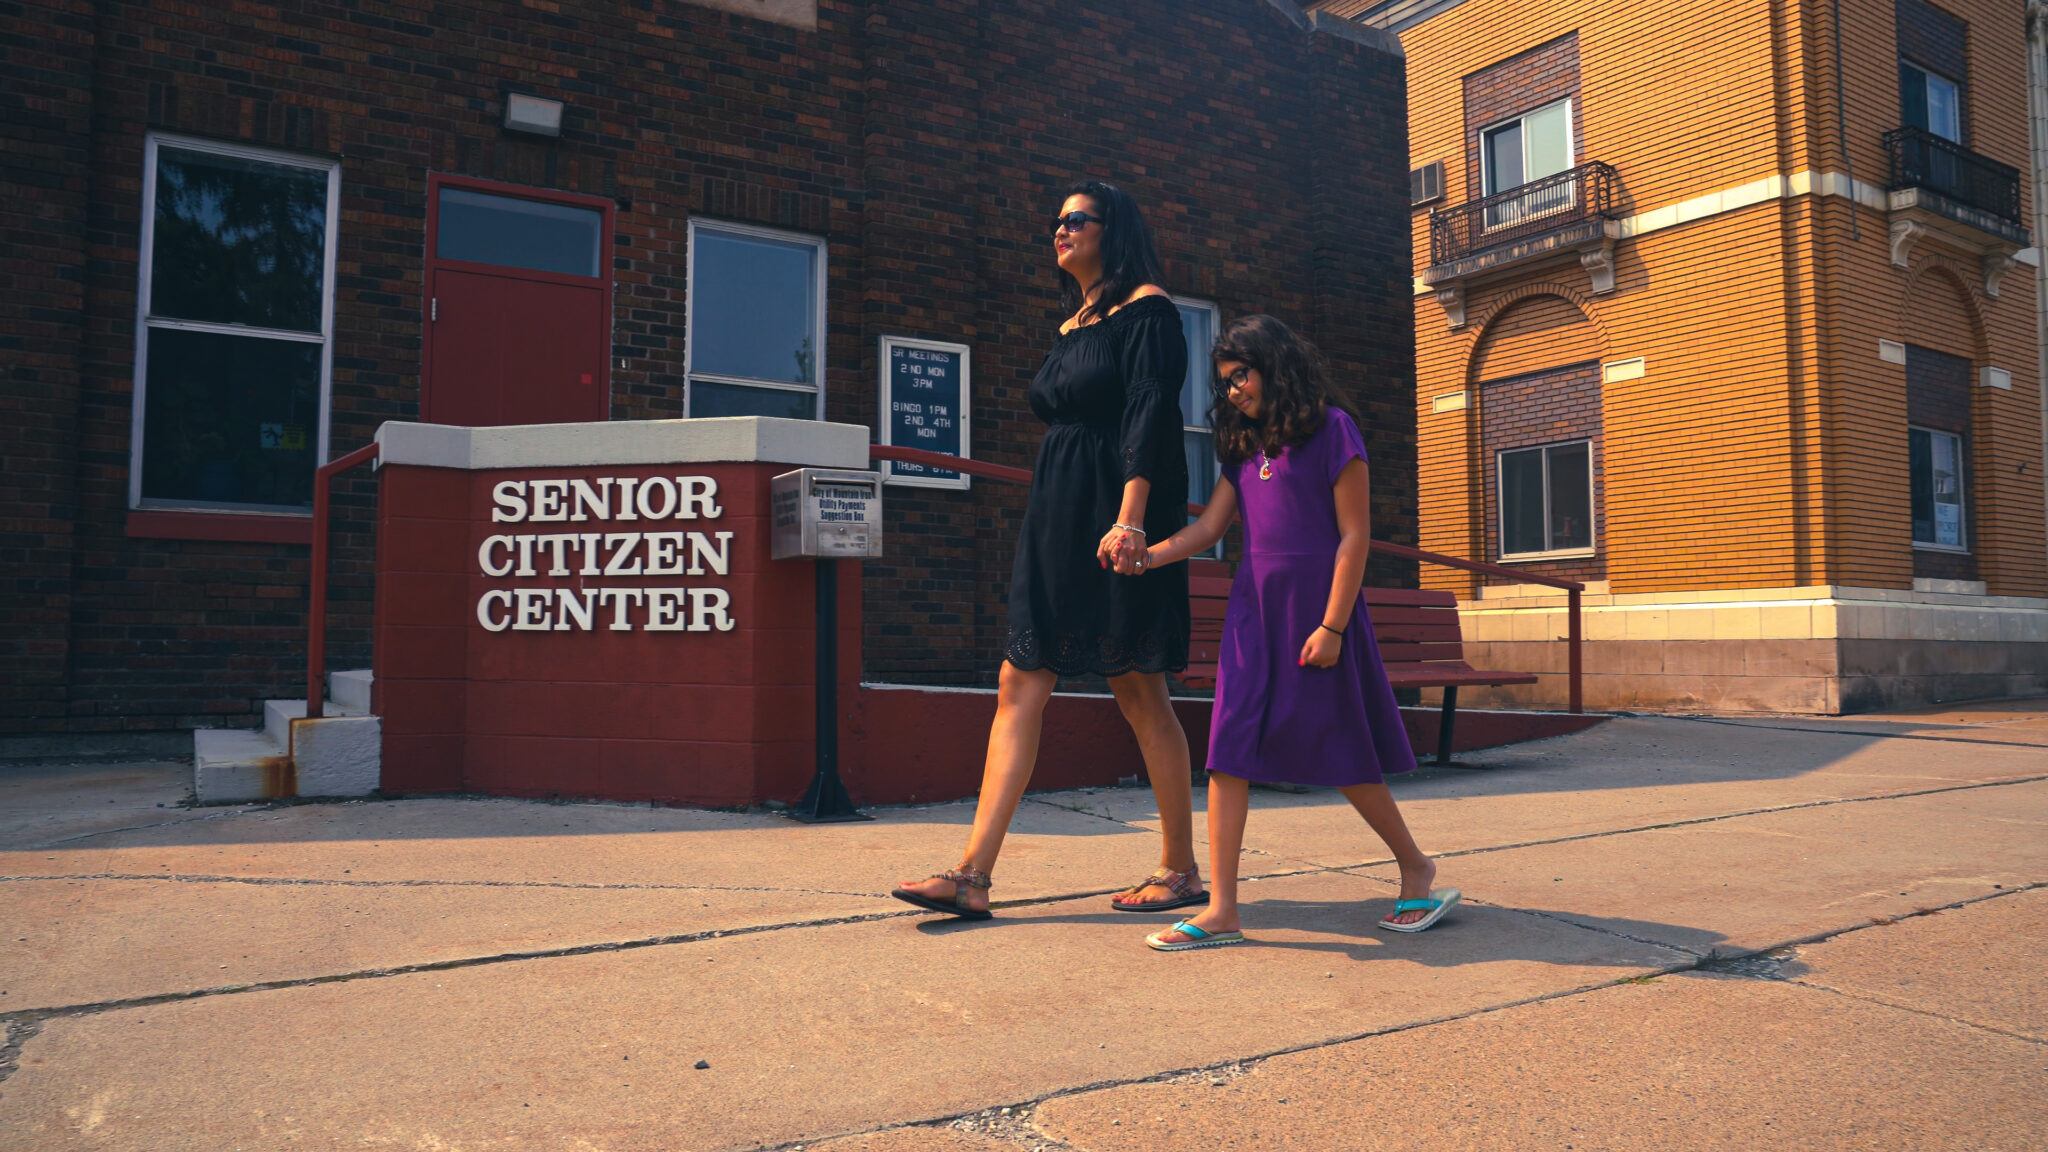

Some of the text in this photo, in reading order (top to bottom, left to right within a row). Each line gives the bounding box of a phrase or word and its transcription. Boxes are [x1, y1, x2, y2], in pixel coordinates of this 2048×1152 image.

[893, 348, 950, 363] SR MEETINGS
[927, 366, 945, 377] MON
[912, 378, 933, 389] 3PM
[893, 401, 947, 416] BINGO 1PM
[904, 415, 951, 428] 2ND 4TH
[917, 428, 936, 438] MON
[492, 475, 723, 523] SENIOR
[826, 488, 832, 498] of
[833, 489, 859, 499] Mountain
[819, 499, 866, 511] Utility Payments
[821, 510, 865, 521] Suggestion Box
[478, 531, 734, 577] CITIZEN
[477, 587, 736, 632] CENTER
